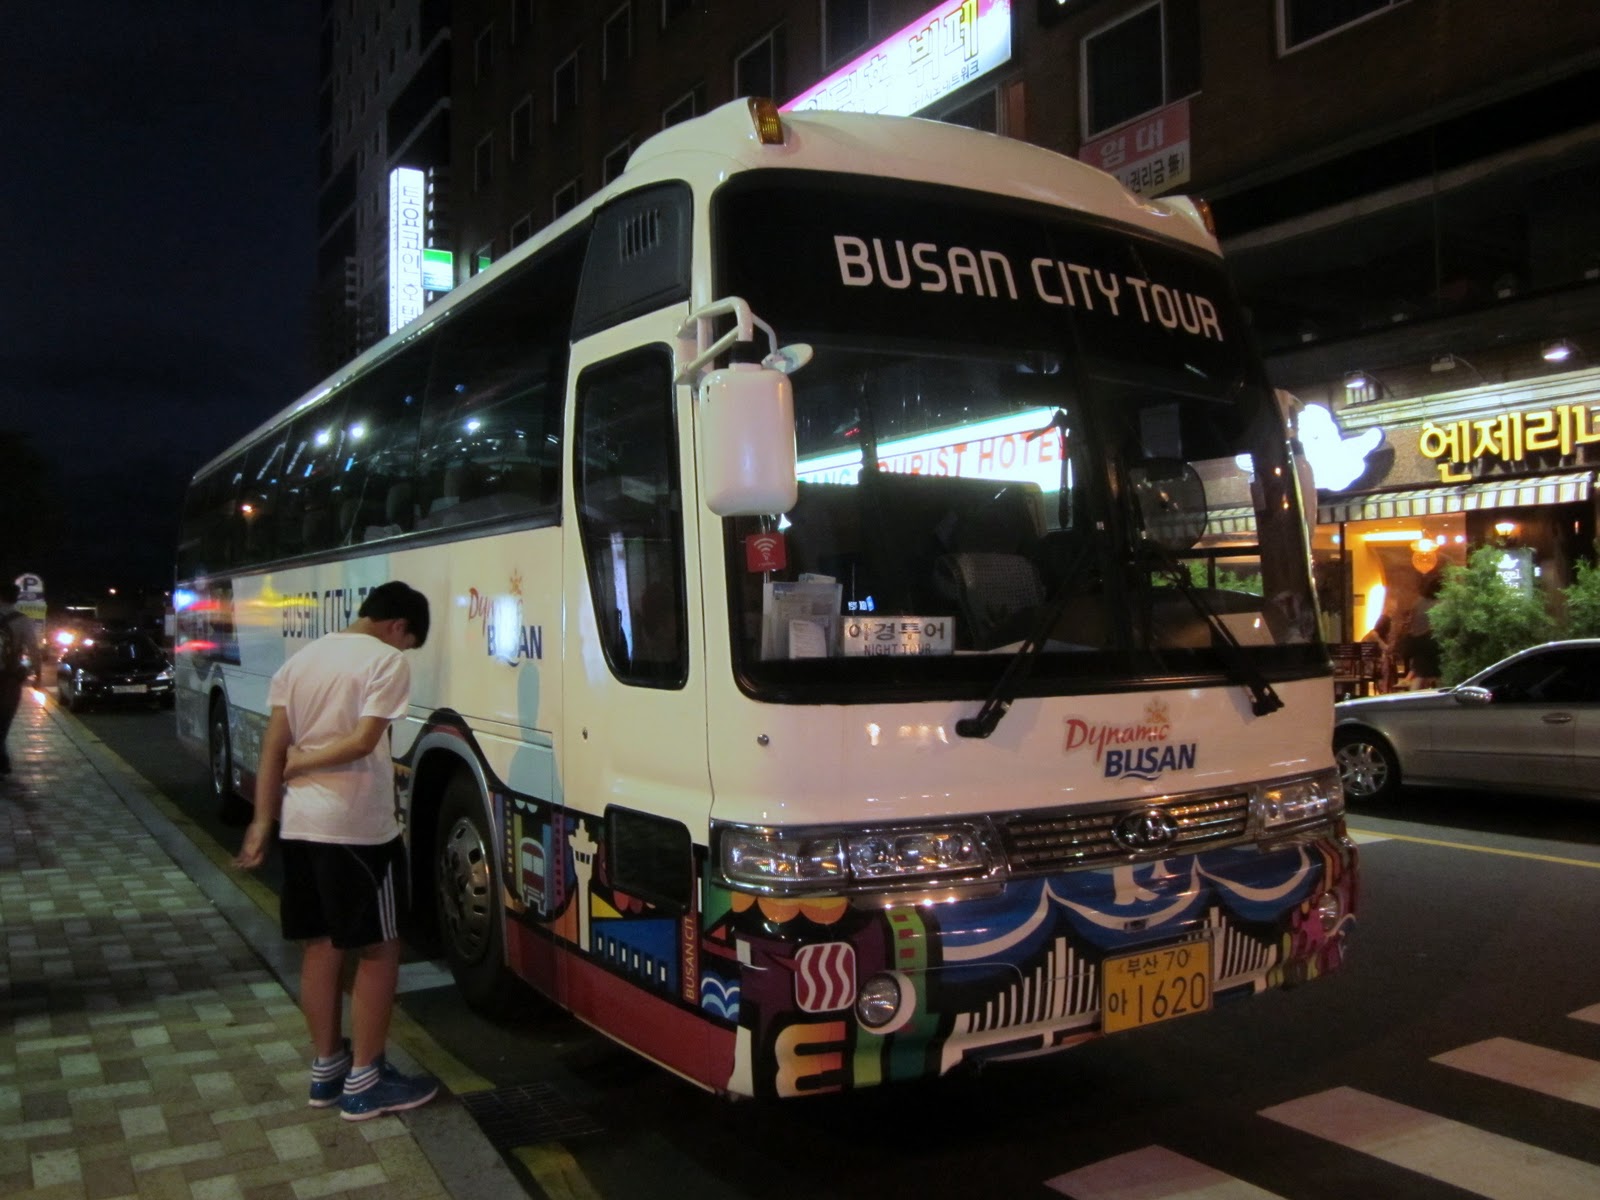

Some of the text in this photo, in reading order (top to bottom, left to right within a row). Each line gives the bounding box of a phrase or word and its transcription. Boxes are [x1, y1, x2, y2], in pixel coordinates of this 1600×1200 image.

[833, 234, 1224, 342] BUSAN CITY TOUR
[878, 442, 968, 478] OURIST
[23, 577, 38, 592] P
[282, 591, 318, 639] BUSAN
[323, 588, 353, 635] CITY
[487, 625, 542, 660] BAN
[864, 644, 931, 656] NIGHT TOUR
[1065, 718, 1171, 763] Dynamic
[1104, 743, 1197, 778] BUSAN
[684, 916, 696, 1001] BUSAN CIT
[1127, 948, 1189, 979] 부산 70
[1108, 972, 1206, 1023] 아 1620
